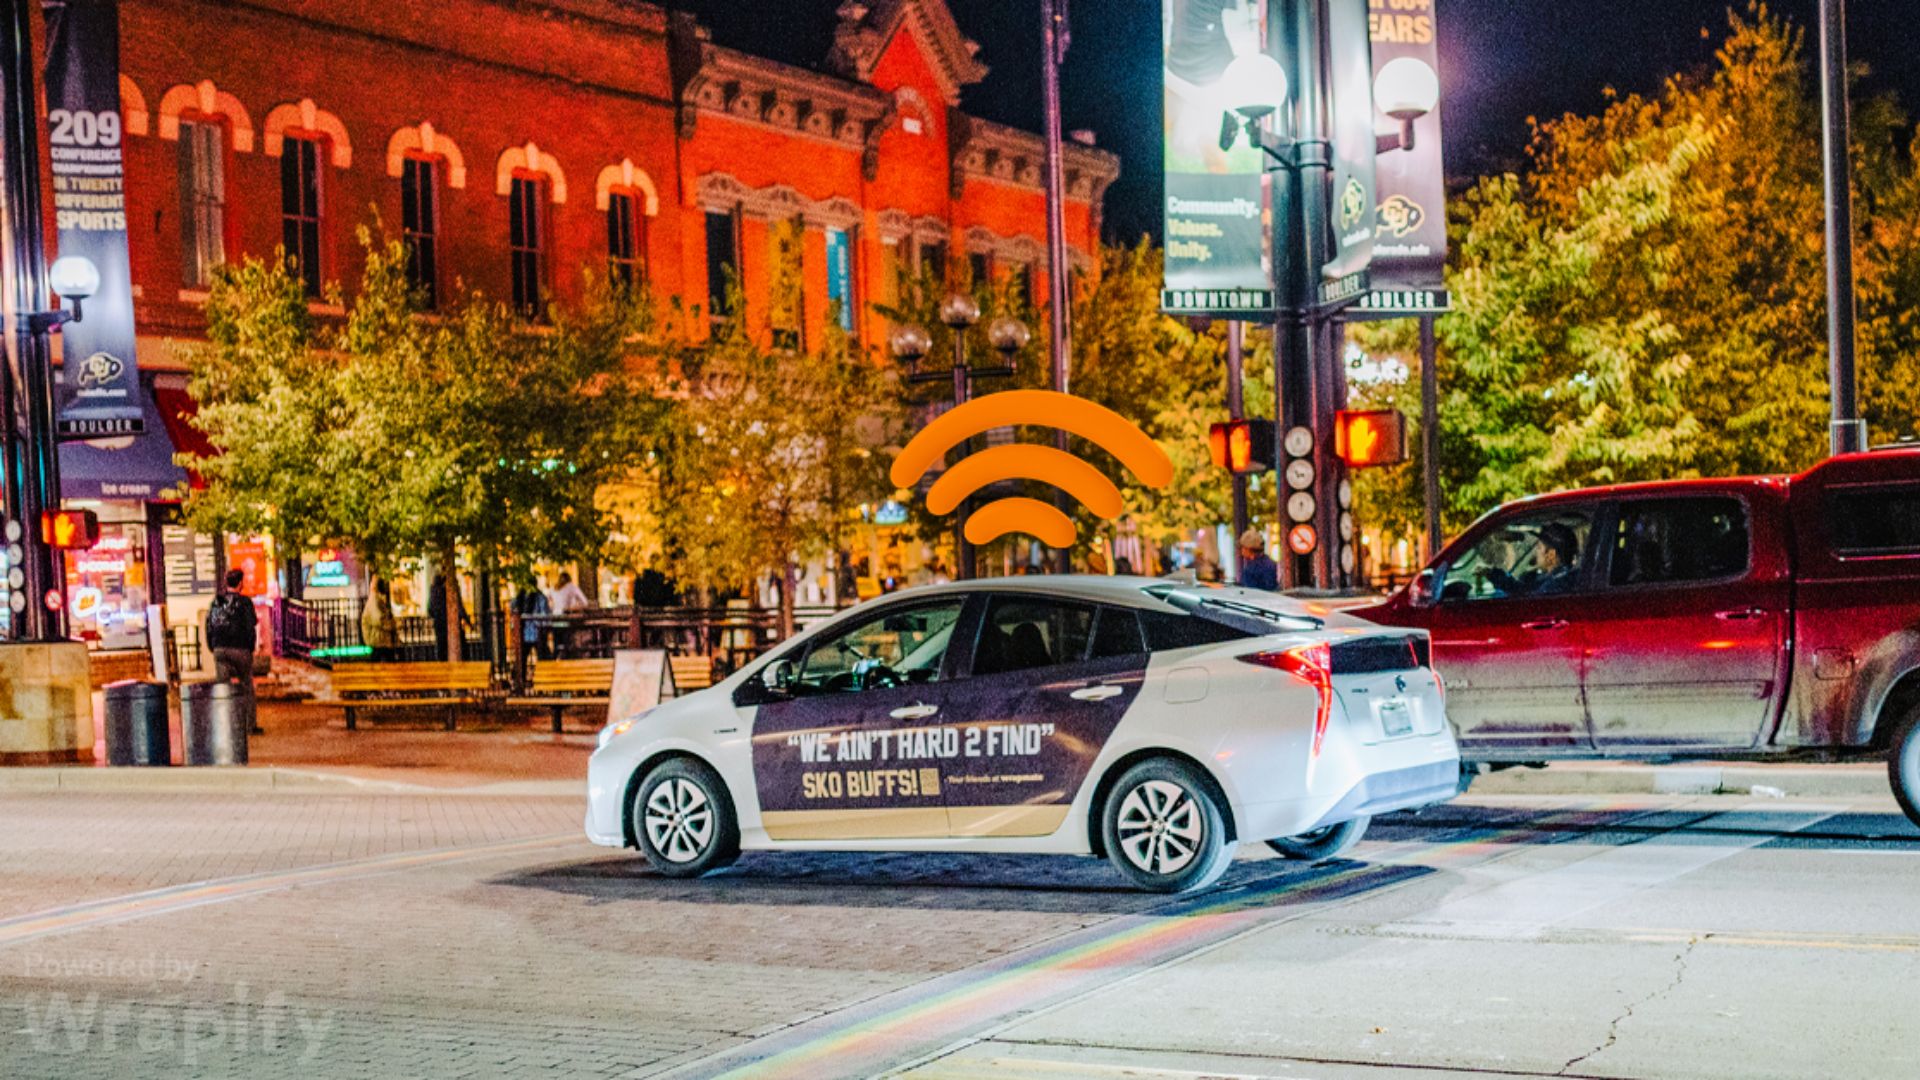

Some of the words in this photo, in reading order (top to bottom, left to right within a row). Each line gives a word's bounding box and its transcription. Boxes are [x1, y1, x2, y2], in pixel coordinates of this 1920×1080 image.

[1369, 13, 1433, 45] EARS
[49, 108, 120, 146] 209
[51, 147, 121, 161] CONFERENCE
[71, 177, 123, 192] TWENTY
[55, 193, 124, 208] DIFFERENT
[1167, 196, 1260, 218] Community.
[56, 211, 126, 231] SPORTS
[1168, 218, 1223, 237] Values.
[1168, 240, 1212, 262] Unity.
[1172, 291, 1263, 308] DOWNTOWN
[69, 420, 132, 432] BOULDER
[118, 484, 151, 495] cream
[787, 732, 832, 762] “WE
[836, 730, 892, 761] AIN’T
[897, 727, 959, 760] HARD
[964, 726, 981, 757] 2
[986, 723, 1055, 757] FIND”
[802, 771, 843, 799] SKO
[846, 768, 919, 798] BUFFS!
